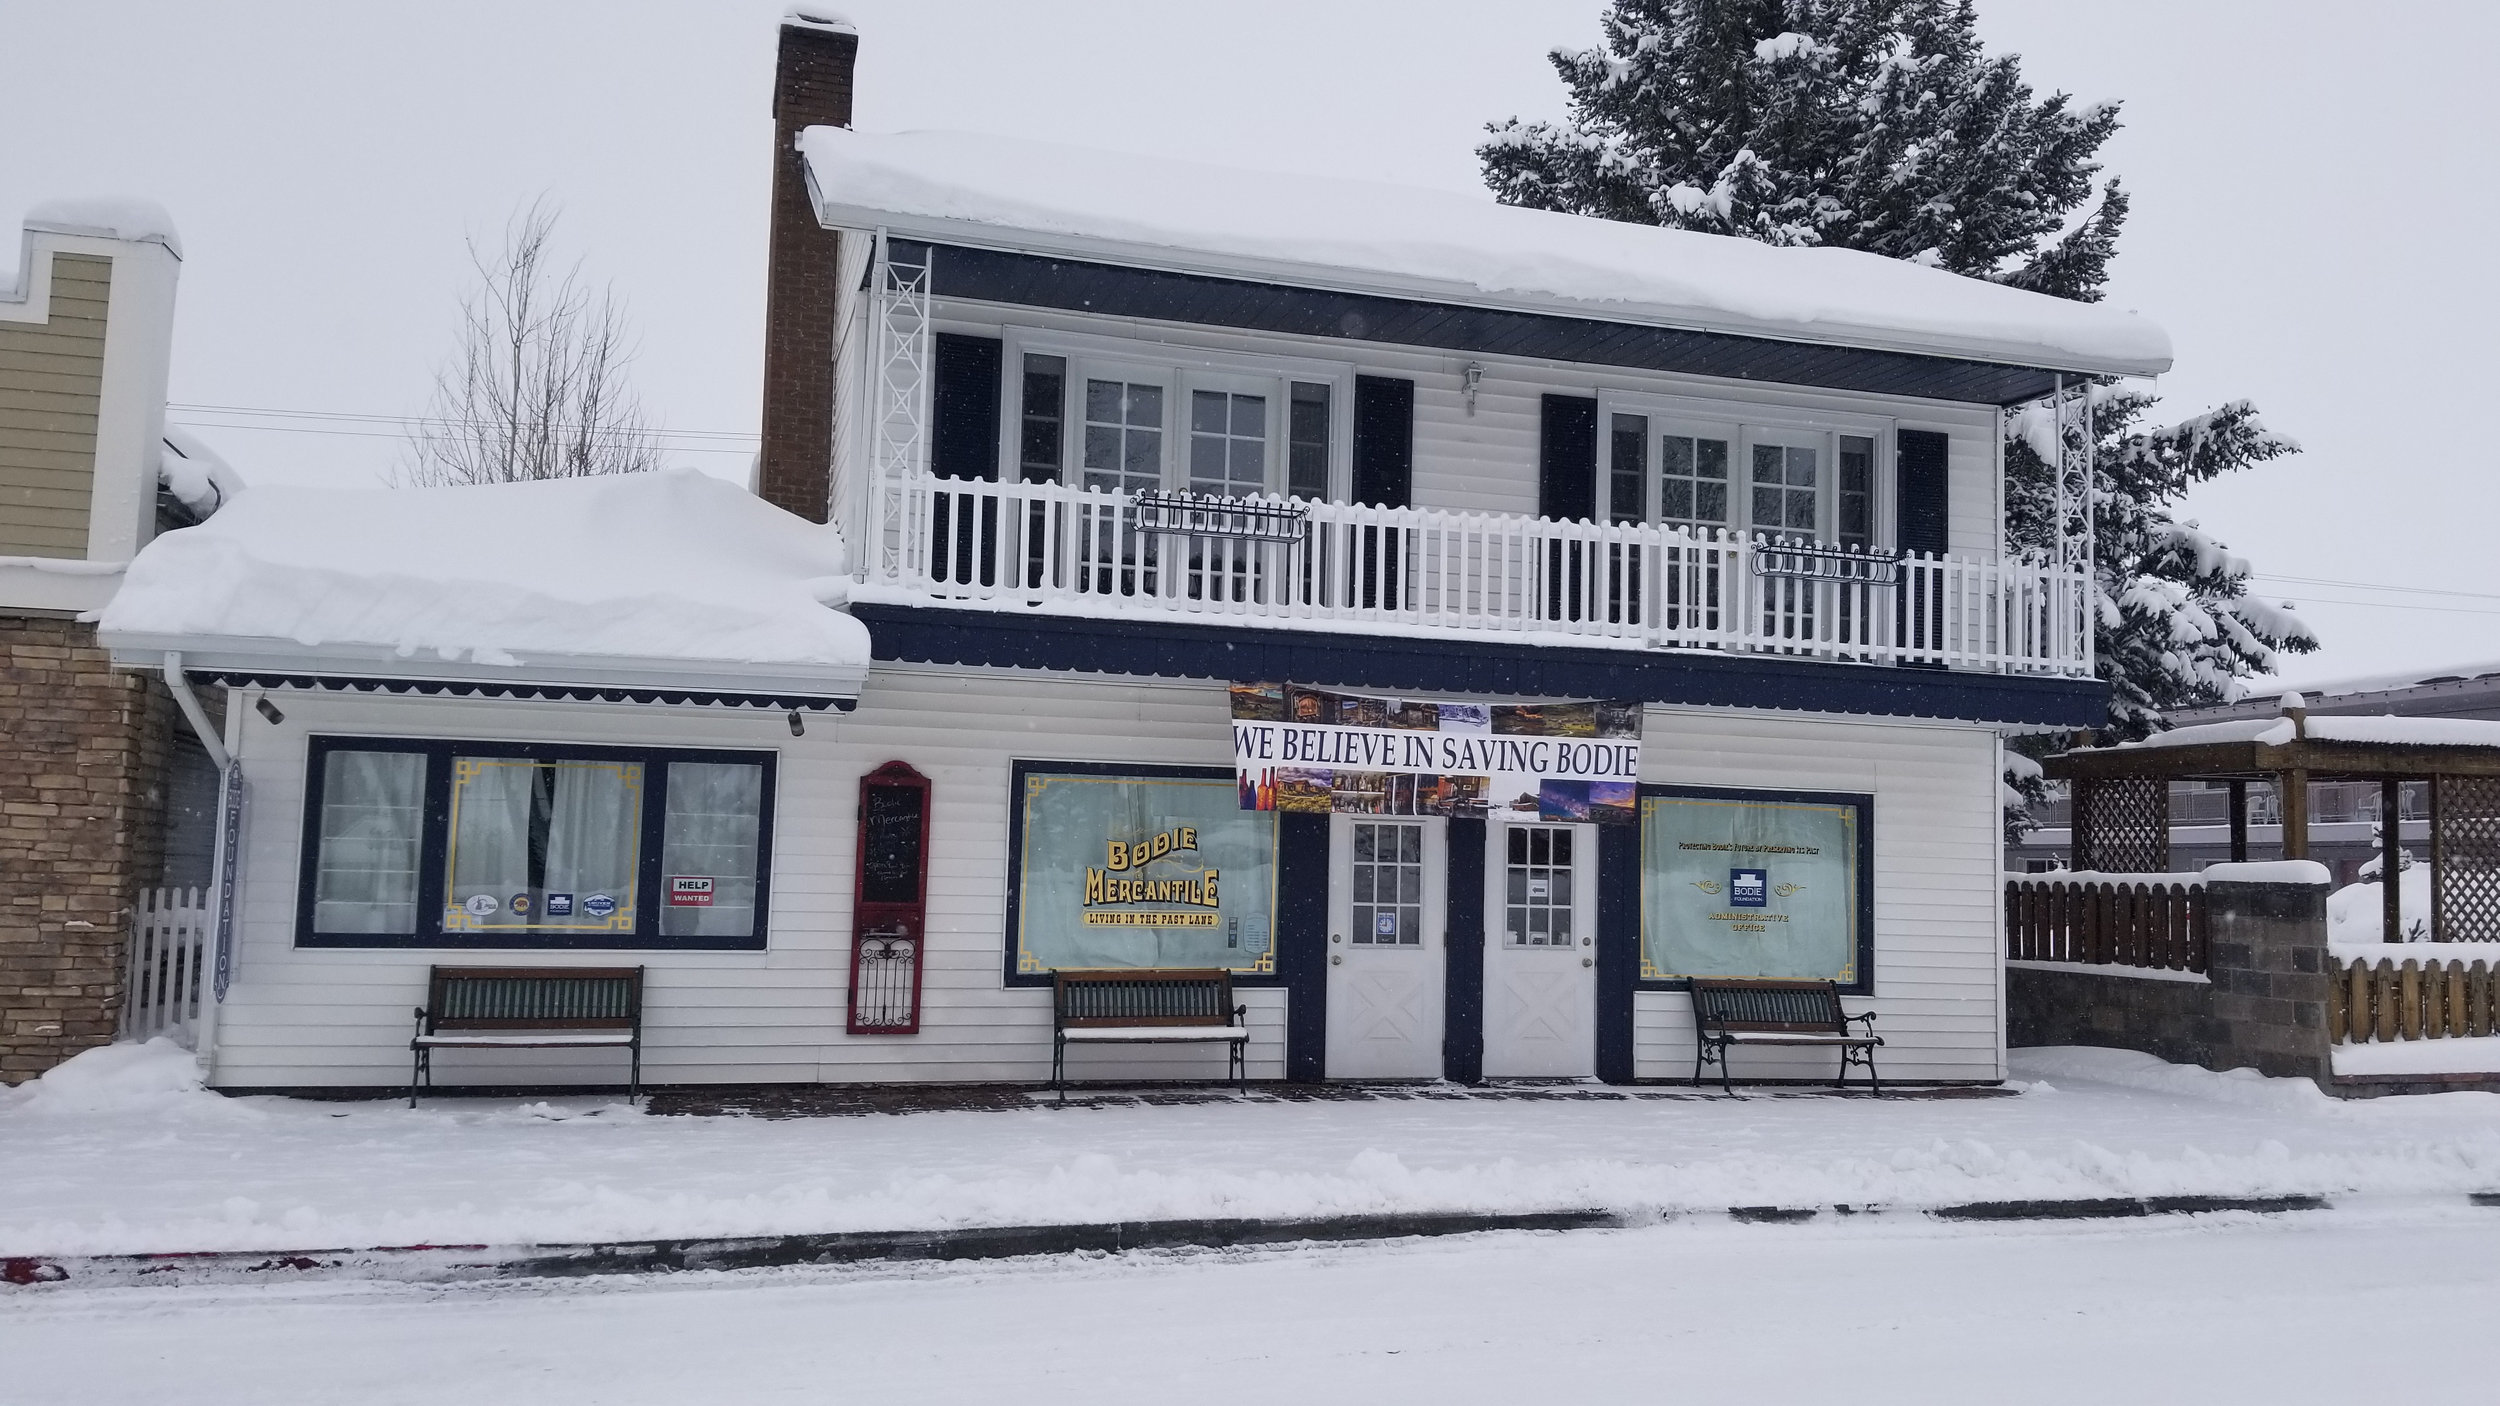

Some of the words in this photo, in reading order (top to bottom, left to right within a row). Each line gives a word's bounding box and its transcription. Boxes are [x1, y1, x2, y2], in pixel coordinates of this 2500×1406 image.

[1233, 725, 1274, 760] WE
[1282, 728, 1396, 766] BELIEVE
[1403, 735, 1434, 769] IN
[1442, 738, 1549, 773] SAVING
[1556, 742, 1638, 776] BODIE
[1106, 827, 1198, 872] BODIE
[678, 881, 709, 890] HELP
[1083, 867, 1219, 908] MERCANTILE
[1734, 887, 1762, 896] BODIE
[217, 810, 238, 989] FOUNDATION
[1089, 914, 1121, 924] LIVING
[1125, 914, 1135, 924] IN
[1140, 914, 1157, 924] THE
[1161, 915, 1185, 925] PAST
[1189, 915, 1213, 925] LANE
[1708, 912, 1789, 922] ADMINISTRATIVE
[1732, 924, 1765, 932] OFFICE
